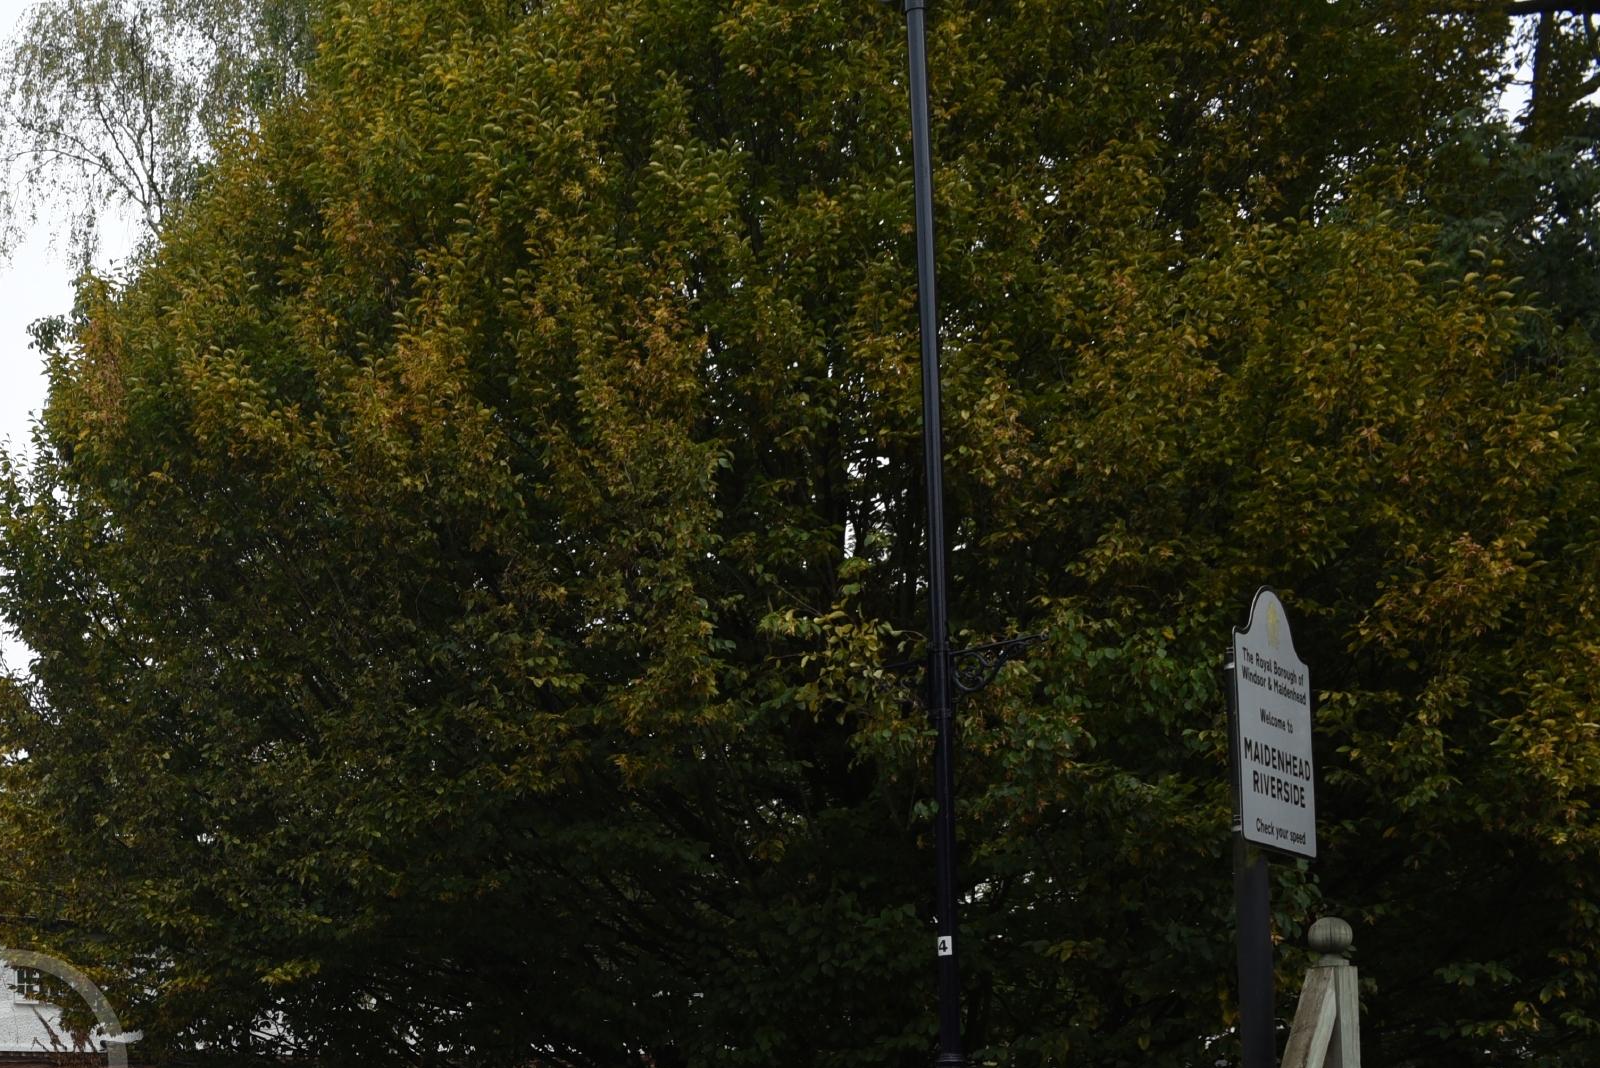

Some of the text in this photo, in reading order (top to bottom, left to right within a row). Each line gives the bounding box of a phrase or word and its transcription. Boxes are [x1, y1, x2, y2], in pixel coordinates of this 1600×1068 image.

[1241, 665, 1307, 706] Windsor & Maidenhead
[1242, 647, 1304, 687] The Royal Borough of
[1259, 708, 1294, 734] Welcome to
[1244, 737, 1311, 782] MAIDENHEAD
[1252, 770, 1306, 809] RIVERSIDE
[1256, 817, 1307, 845] Check your speed
[939, 939, 948, 952] 4
